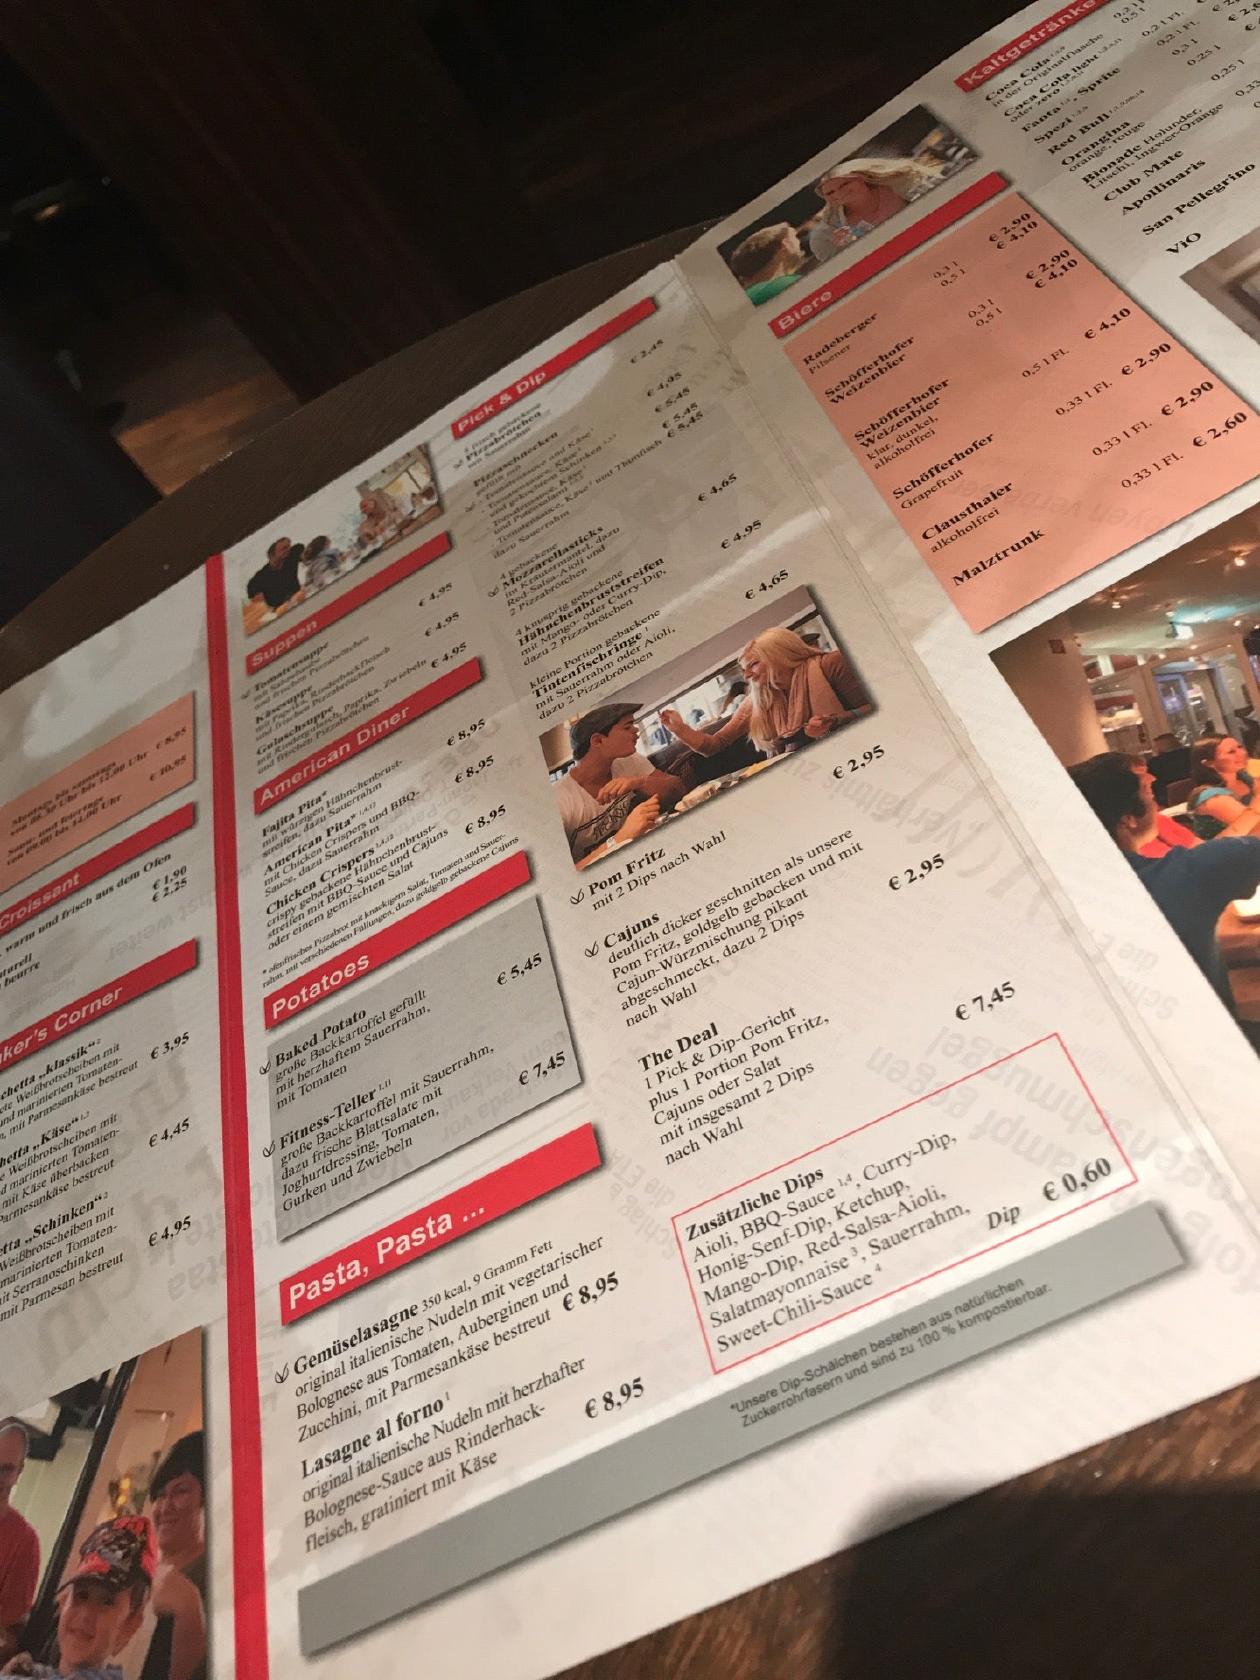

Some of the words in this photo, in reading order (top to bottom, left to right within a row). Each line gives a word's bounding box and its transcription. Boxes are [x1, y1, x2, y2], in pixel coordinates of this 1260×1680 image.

[964, 0, 1096, 84] Kaltgetränke
[1047, 133, 1077, 154] Red
[1078, 112, 1110, 134] Bull
[1061, 121, 1130, 165] Orangina
[1081, 144, 1142, 184] Bionade
[1143, 108, 1202, 144] Holunder,
[1104, 177, 1141, 201] Club
[1142, 150, 1183, 177] Mate
[1122, 160, 1205, 215] Apollinaris
[1142, 214, 1174, 235] San
[1174, 164, 1255, 214] Pellegrino
[1165, 232, 1201, 253] ViO
[778, 291, 831, 330] Biere
[1084, 328, 1095, 339] €
[1099, 307, 1131, 331] 4,10
[802, 313, 877, 365] Radeberger
[824, 336, 914, 398] Schöfferhofer
[1121, 364, 1133, 375] €
[1134, 342, 1171, 368] 2,90
[457, 405, 493, 431] Pick
[499, 392, 512, 404] &
[515, 371, 546, 394] Dip
[829, 353, 905, 403] Weizenbier
[1161, 404, 1173, 416] €
[1174, 381, 1214, 408] 2,90
[854, 379, 948, 441] Schöfferhofer
[859, 396, 940, 448] Weizenbier
[866, 443, 894, 460] klar,
[895, 415, 938, 443] dunkel,
[1192, 436, 1207, 447] €
[1207, 412, 1247, 439] 2,60
[874, 427, 935, 469] alkoholfrei
[892, 433, 993, 499] Schöfferhofer
[900, 469, 964, 509] Grapefruit
[921, 482, 1012, 540] Clausthaler
[720, 538, 728, 549] €
[732, 519, 761, 541] 4,95
[930, 506, 999, 552] alkoholfrei
[502, 526, 603, 590] Mozzarellasticks
[744, 588, 753, 599] €
[758, 568, 788, 592] 4,65
[952, 529, 1044, 586] Malztrunk
[518, 557, 664, 646] Hähnchenbruststreifen
[252, 620, 317, 666] Suppen
[529, 667, 562, 689] kleine
[563, 643, 603, 669] Portion
[604, 610, 660, 647] gebackene
[532, 632, 642, 698] Tintenfischringe
[538, 701, 565, 720] dazu
[566, 694, 574, 704] 2
[576, 651, 653, 698] Pizzabrötchen
[256, 705, 333, 755] Gulaschsuppe
[260, 742, 350, 805] American
[356, 706, 409, 745] Diner
[832, 765, 843, 779] €
[847, 744, 884, 772] 2,95
[262, 812, 295, 837] Fajita
[464, 822, 473, 834] €
[477, 804, 506, 828] 8,95
[266, 880, 316, 914] Chicken
[319, 847, 375, 883] Crispers
[588, 871, 623, 896] Pom
[625, 848, 666, 875] Fritz
[608, 930, 660, 964] deutlich
[661, 907, 702, 935] dicker
[705, 867, 782, 915] geschnitten
[784, 855, 804, 871] als
[806, 830, 852, 858] unsere
[4, 930, 35, 952] warm
[38, 914, 59, 934] und
[61, 897, 92, 920] frisch
[94, 884, 114, 900] aus
[116, 870, 140, 888] dem
[142, 853, 171, 872] Ofen
[267, 932, 290, 950] oder
[292, 912, 324, 935] einem
[326, 877, 385, 919] gemischten
[387, 860, 414, 880] Salat
[603, 913, 660, 948] Cajuns
[53, 987, 122, 1031] Corner
[272, 954, 369, 1019] Potatoes
[150, 1046, 159, 1059] €
[162, 1031, 189, 1054] 3,95
[275, 1032, 318, 1067] Baked
[322, 1009, 366, 1040] Potato
[637, 1048, 673, 1071] The
[676, 1022, 718, 1053] Deal
[518, 1069, 528, 1085] €
[532, 1050, 565, 1078] 7,45
[148, 1133, 157, 1147] €
[160, 1117, 189, 1140] 4,45
[280, 1088, 376, 1150] Fitness-Teller
[282, 1182, 327, 1211] Gurken
[330, 1164, 353, 1187] und
[356, 1136, 412, 1173] Zwiebeln
[694, 1231, 738, 1263] Aioli,
[739, 1187, 835, 1239] BBQ-Sauce
[862, 1133, 957, 1181] Curry-Dip,
[1043, 1181, 1058, 1201] €
[1061, 1158, 1112, 1193] 0,60
[148, 1231, 157, 1247] €
[160, 1215, 191, 1240] 4,95
[685, 1189, 780, 1241] Zusätzliche
[783, 1169, 824, 1194] Dips
[697, 1216, 832, 1284] Honig-Senf-Dip,
[833, 1180, 910, 1220] Ketchup,
[987, 1206, 1020, 1230] Dip
[12, 1245, 104, 1299] Serranoschinken
[289, 1259, 368, 1310] Pasta,
[376, 1213, 452, 1264] Pasta
[703, 1255, 803, 1306] Mango-Dip,
[805, 1187, 946, 1258] Red-Salsa-Aioli,
[709, 1256, 849, 1328] Salatmayonnaise
[868, 1204, 970, 1256] Sauerrahm,
[0, 1304, 18, 1319] mit
[21, 1277, 75, 1311] Parmesan
[78, 1252, 123, 1282] bestreut
[293, 1304, 418, 1375] Gemüselasagne
[422, 1293, 441, 1312] 350
[444, 1280, 471, 1300] kcal,
[472, 1274, 480, 1284] 9
[483, 1253, 528, 1280] Gramm
[530, 1240, 552, 1258] Fett
[562, 1292, 572, 1311] €
[578, 1270, 618, 1304] 8,95
[716, 1273, 873, 1353] Sweet-Chili-Sauce
[295, 1360, 346, 1397] original
[349, 1325, 424, 1370] italienische
[427, 1298, 478, 1331] Nudeln
[480, 1283, 506, 1305] mit
[508, 1236, 603, 1290] vegetarischer
[779, 1347, 868, 1393] Dip-Schälchen
[868, 1321, 928, 1353] bestehen
[928, 1310, 953, 1327] aus
[954, 1278, 1024, 1315] natürlichen
[741, 1375, 843, 1428] Zuckerrohrfasern
[844, 1361, 869, 1381] und
[870, 1348, 897, 1369] sind
[898, 1343, 915, 1357] zu
[917, 1329, 941, 1347] 100
[941, 1324, 956, 1335] %
[956, 1284, 1051, 1330] kompostierbar.
[301, 1434, 371, 1479] Lasagne
[376, 1418, 392, 1442] al
[395, 1399, 444, 1432] forno
